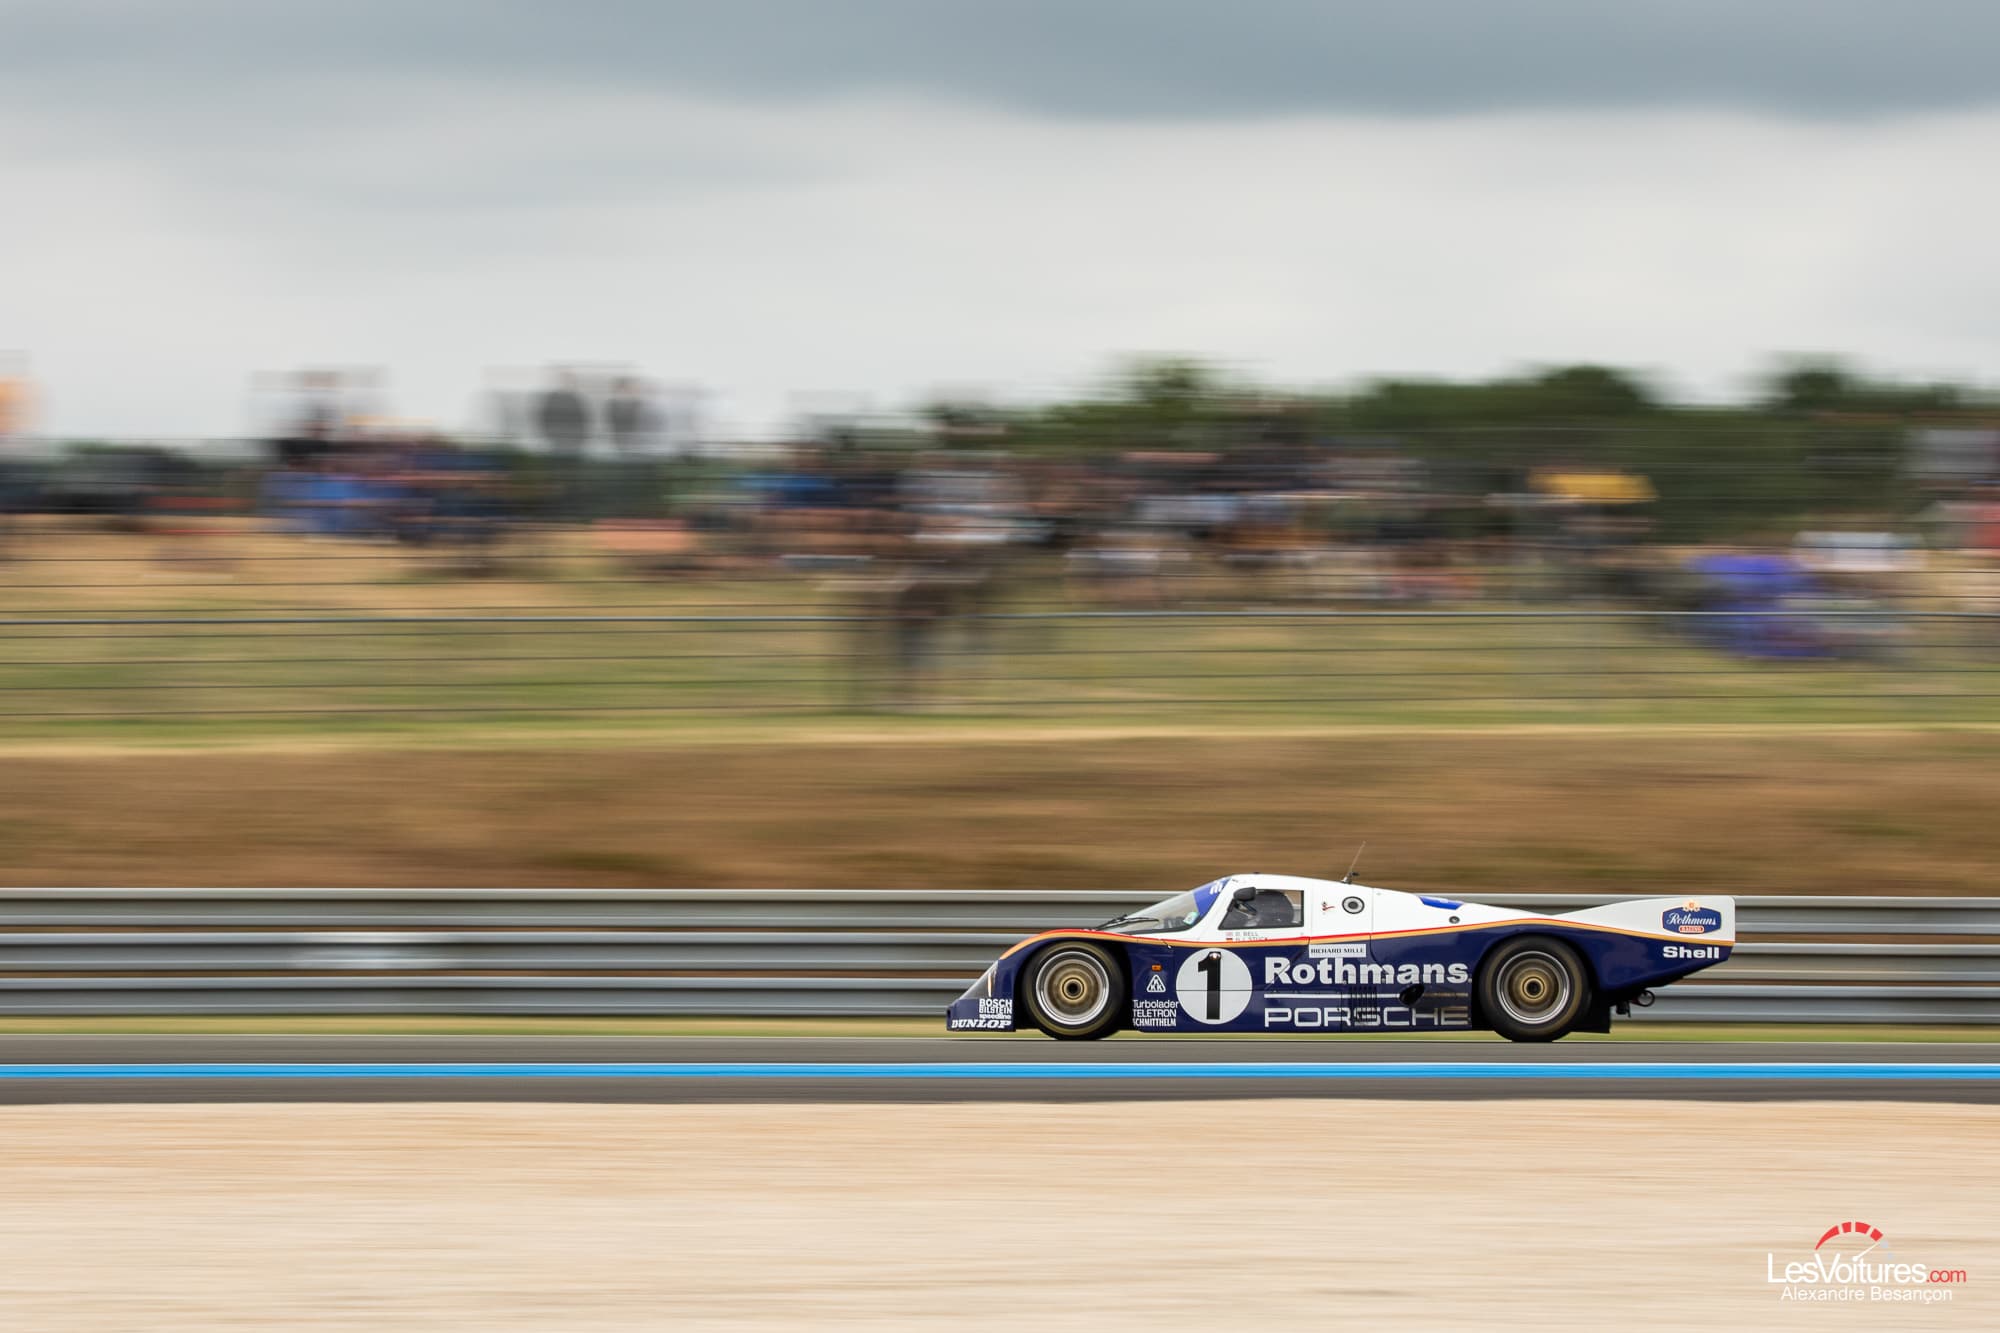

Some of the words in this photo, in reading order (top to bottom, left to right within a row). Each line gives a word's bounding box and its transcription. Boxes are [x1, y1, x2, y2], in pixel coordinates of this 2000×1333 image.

[1666, 912, 1717, 926] Rothmans
[1662, 945, 1720, 959] Shell
[1264, 957, 1469, 985] Rothmans
[1197, 951, 1221, 1020] 1
[979, 998, 1013, 1008] BOSCH
[1132, 999, 1179, 1009] Turbolader
[979, 1006, 1013, 1014] BILSTEIN
[1132, 1008, 1177, 1018] TELETRON
[1264, 1006, 1469, 1027] PORSCHE
[951, 1019, 1012, 1029] DUNLOP
